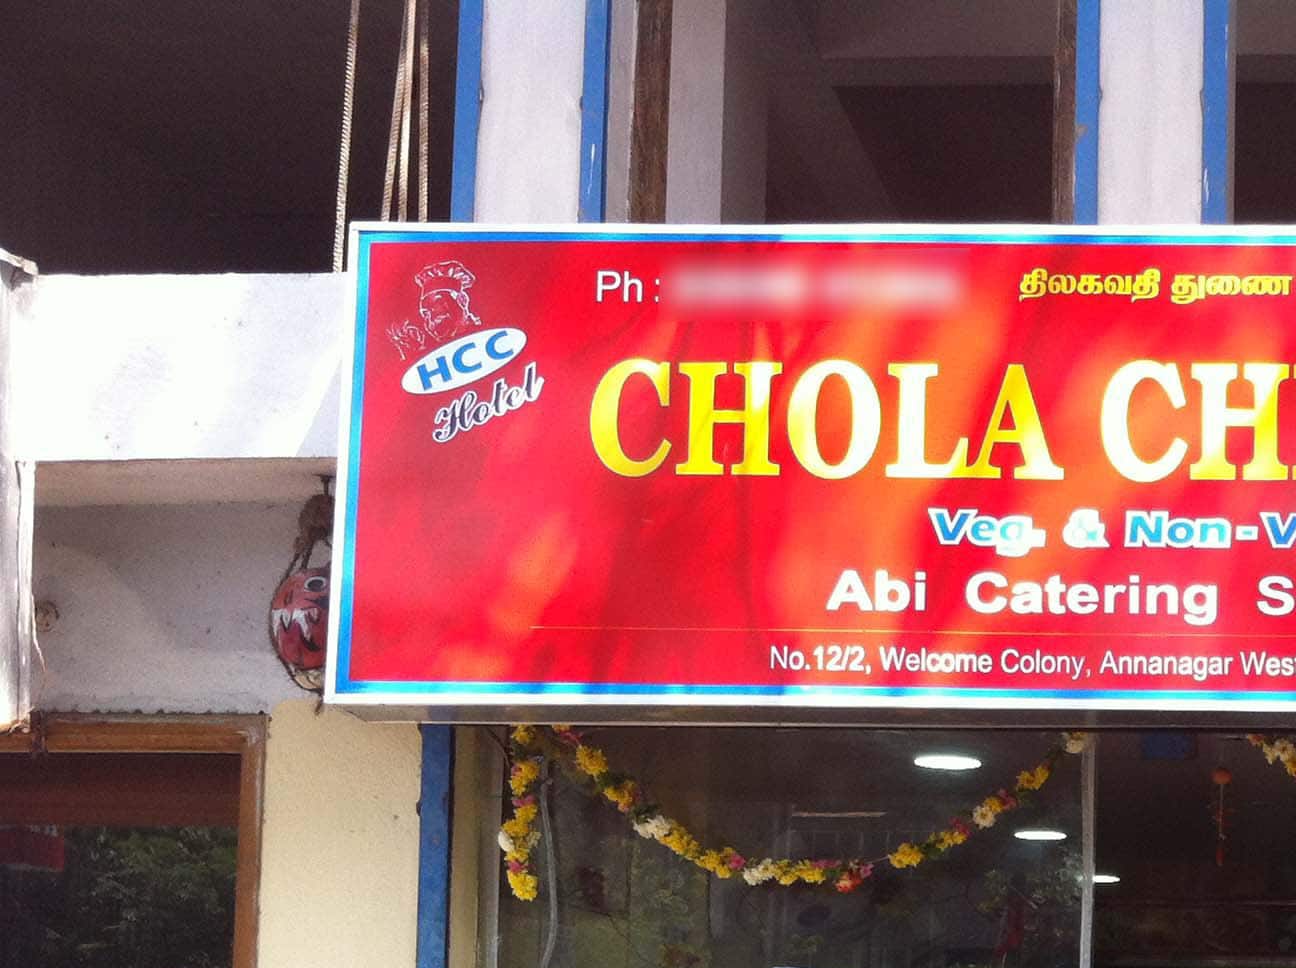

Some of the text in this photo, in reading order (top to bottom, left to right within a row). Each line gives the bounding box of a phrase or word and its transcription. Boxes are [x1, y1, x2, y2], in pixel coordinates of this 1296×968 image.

[596, 269, 643, 303] Ph
[1019, 267, 1293, 304] திலகவதி துணை
[416, 330, 514, 391] HCC
[432, 361, 545, 443] Hotel
[589, 357, 1064, 481] CHOLA
[927, 507, 1047, 557] Veg.
[1063, 509, 1110, 549] &
[826, 569, 927, 612] Abi
[965, 571, 1219, 626] Catering
[769, 646, 872, 674] No.12/2,
[879, 647, 993, 673] Welcome
[1000, 649, 1092, 680] Colony,
[1100, 651, 1233, 681] Annanagar
